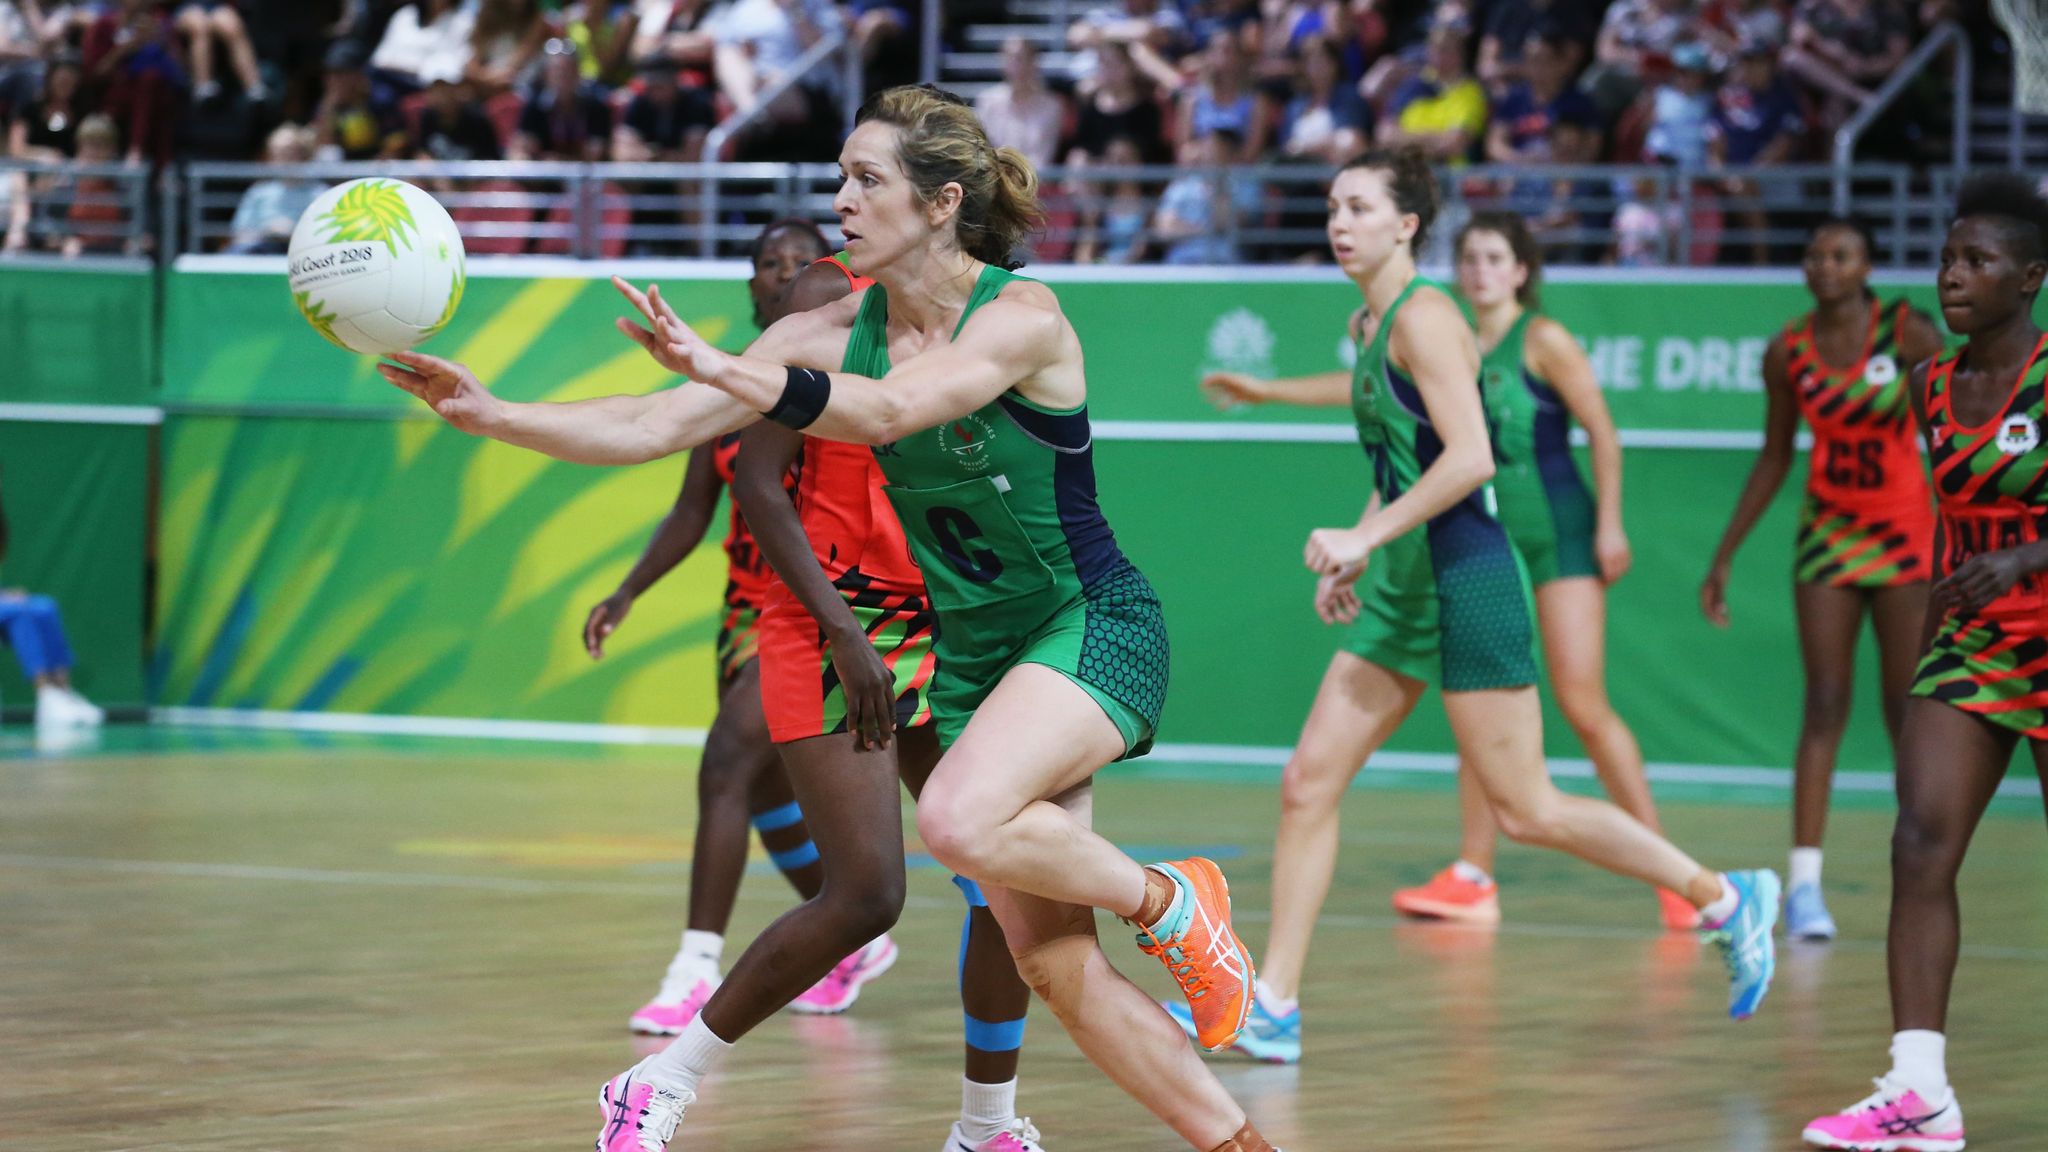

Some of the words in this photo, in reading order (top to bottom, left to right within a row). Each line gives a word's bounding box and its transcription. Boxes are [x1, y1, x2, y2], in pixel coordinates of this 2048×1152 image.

[302, 252, 335, 273] Coast
[340, 246, 373, 264] 2018
[1575, 335, 1643, 392] HE
[1655, 336, 1766, 393] DRE
[974, 415, 997, 440] GAMES
[925, 506, 1004, 584] C
